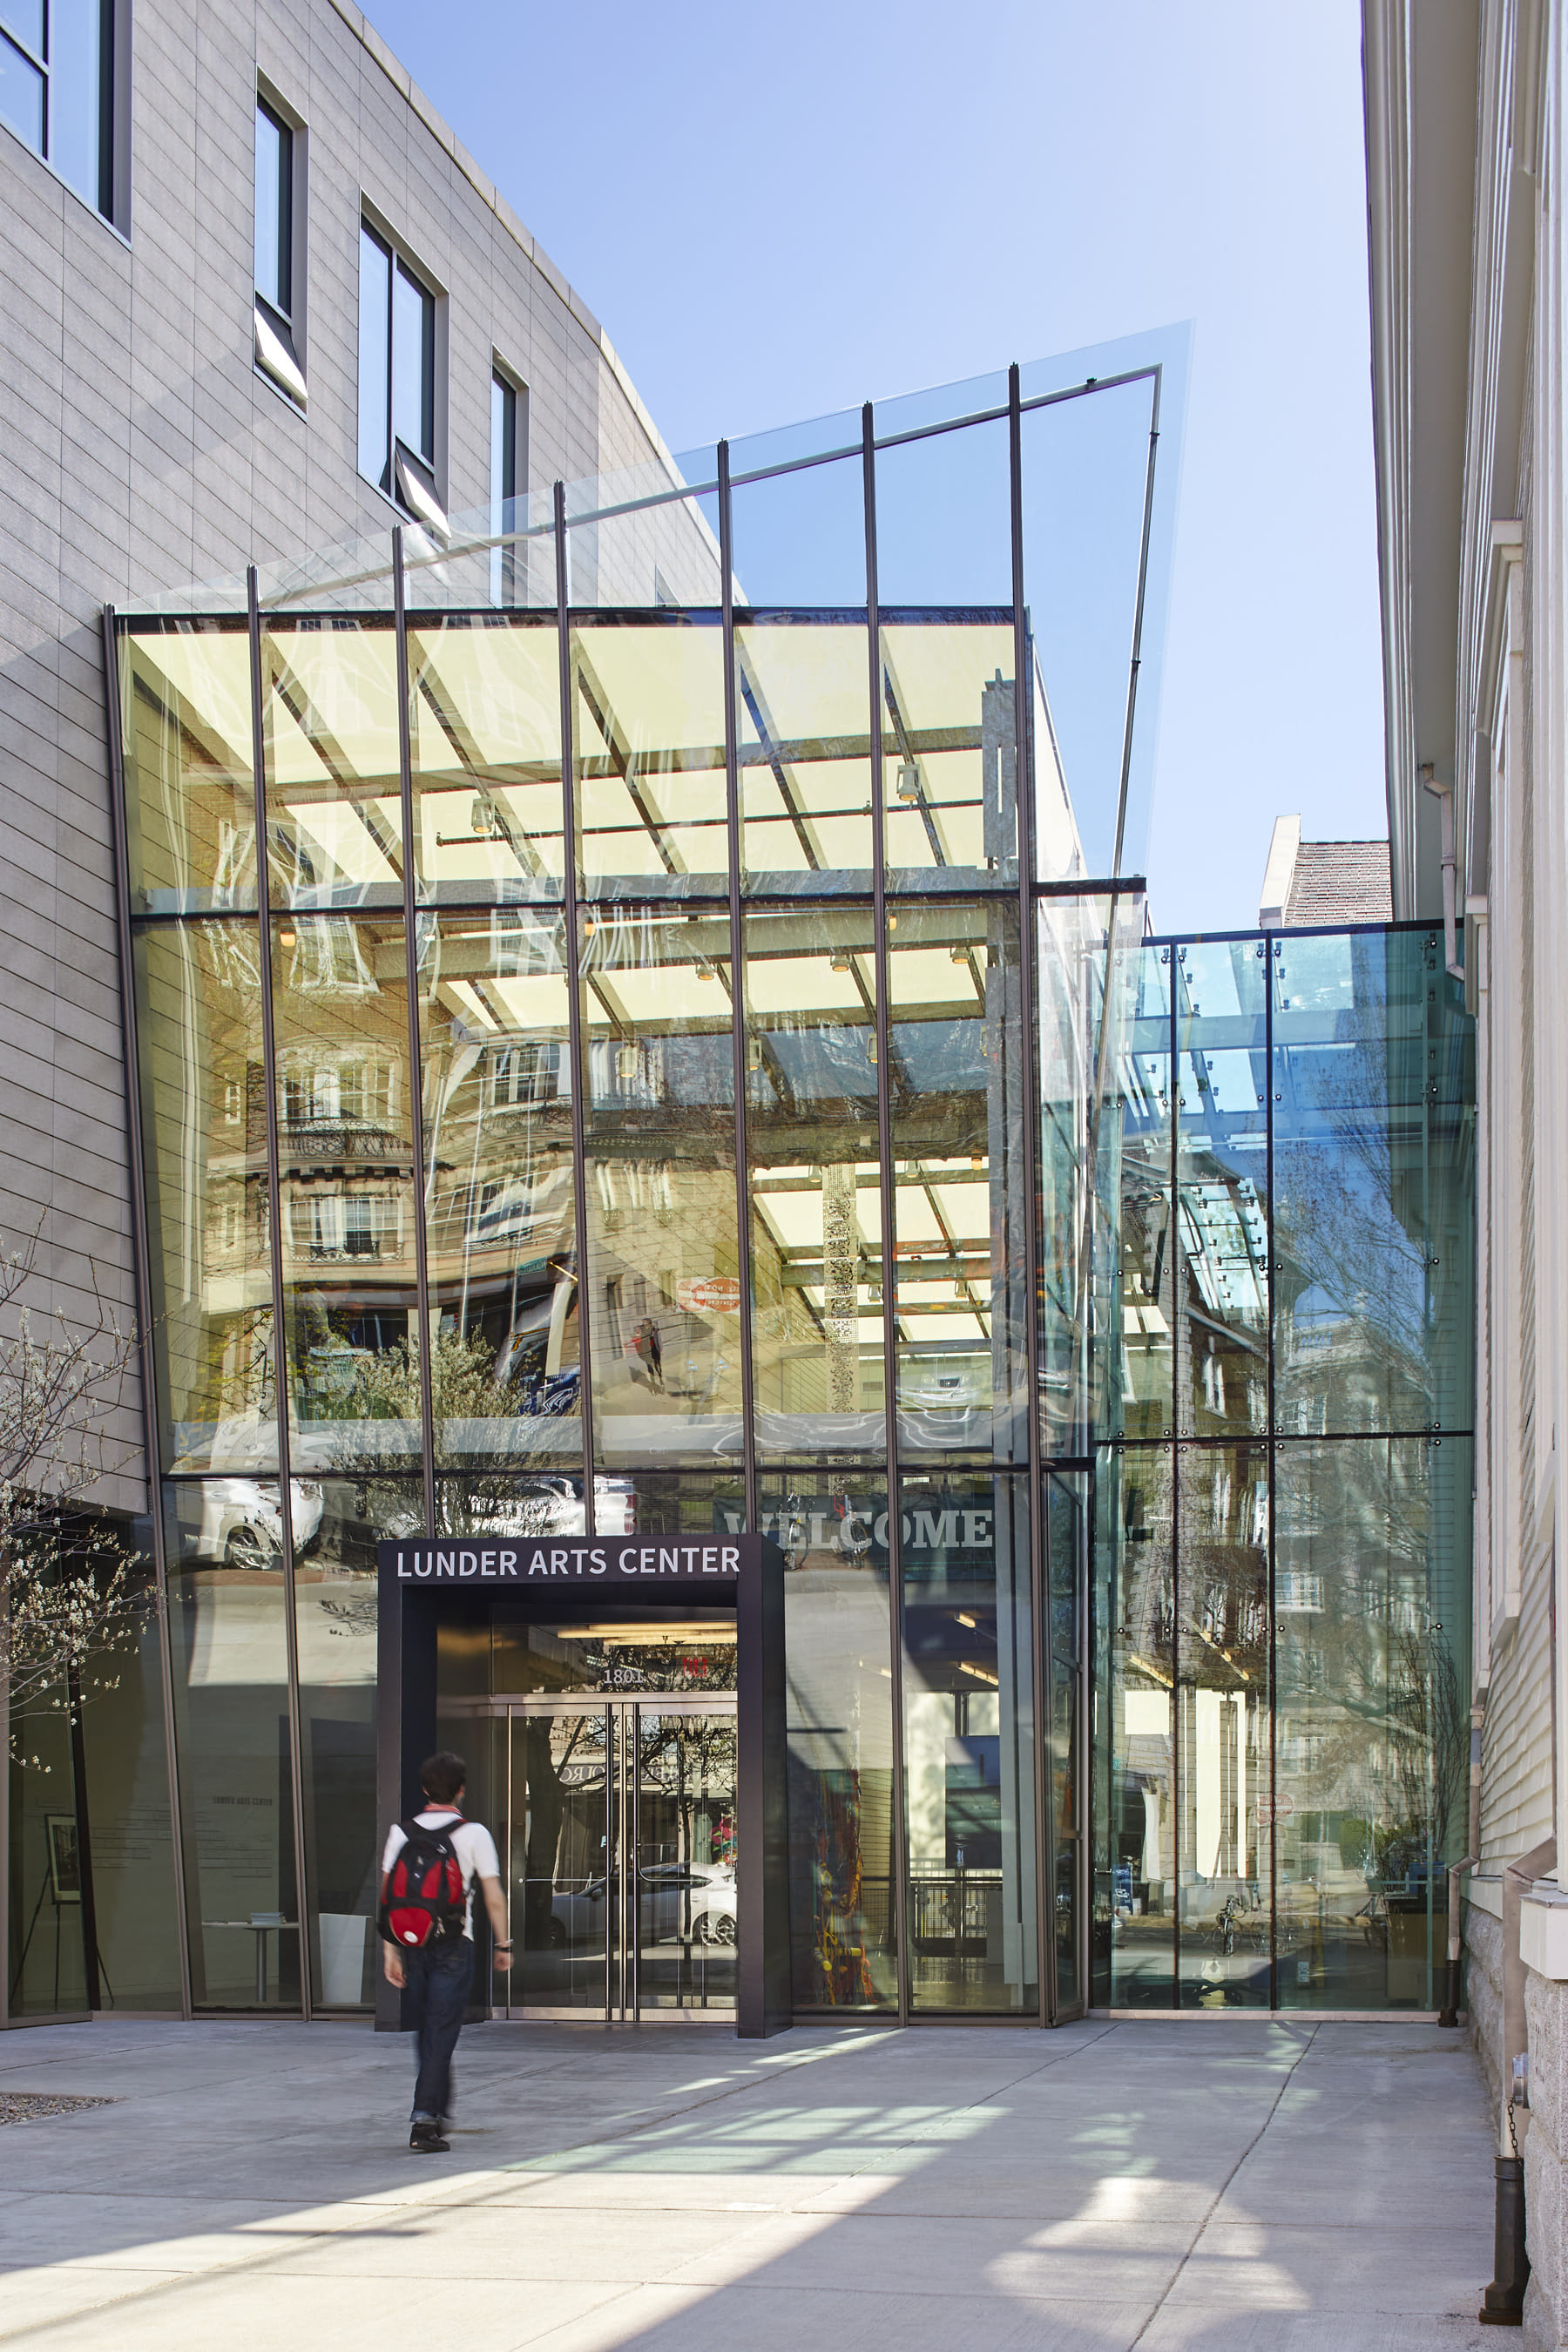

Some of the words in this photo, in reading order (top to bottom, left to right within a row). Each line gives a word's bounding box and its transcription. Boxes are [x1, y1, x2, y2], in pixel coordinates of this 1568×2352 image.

[723, 1511, 993, 1550] WELCOME
[397, 1551, 517, 1578] LUNDER
[528, 1549, 607, 1575] ARTS
[618, 1546, 740, 1573] CENTER
[604, 1668, 643, 1685] 1801
